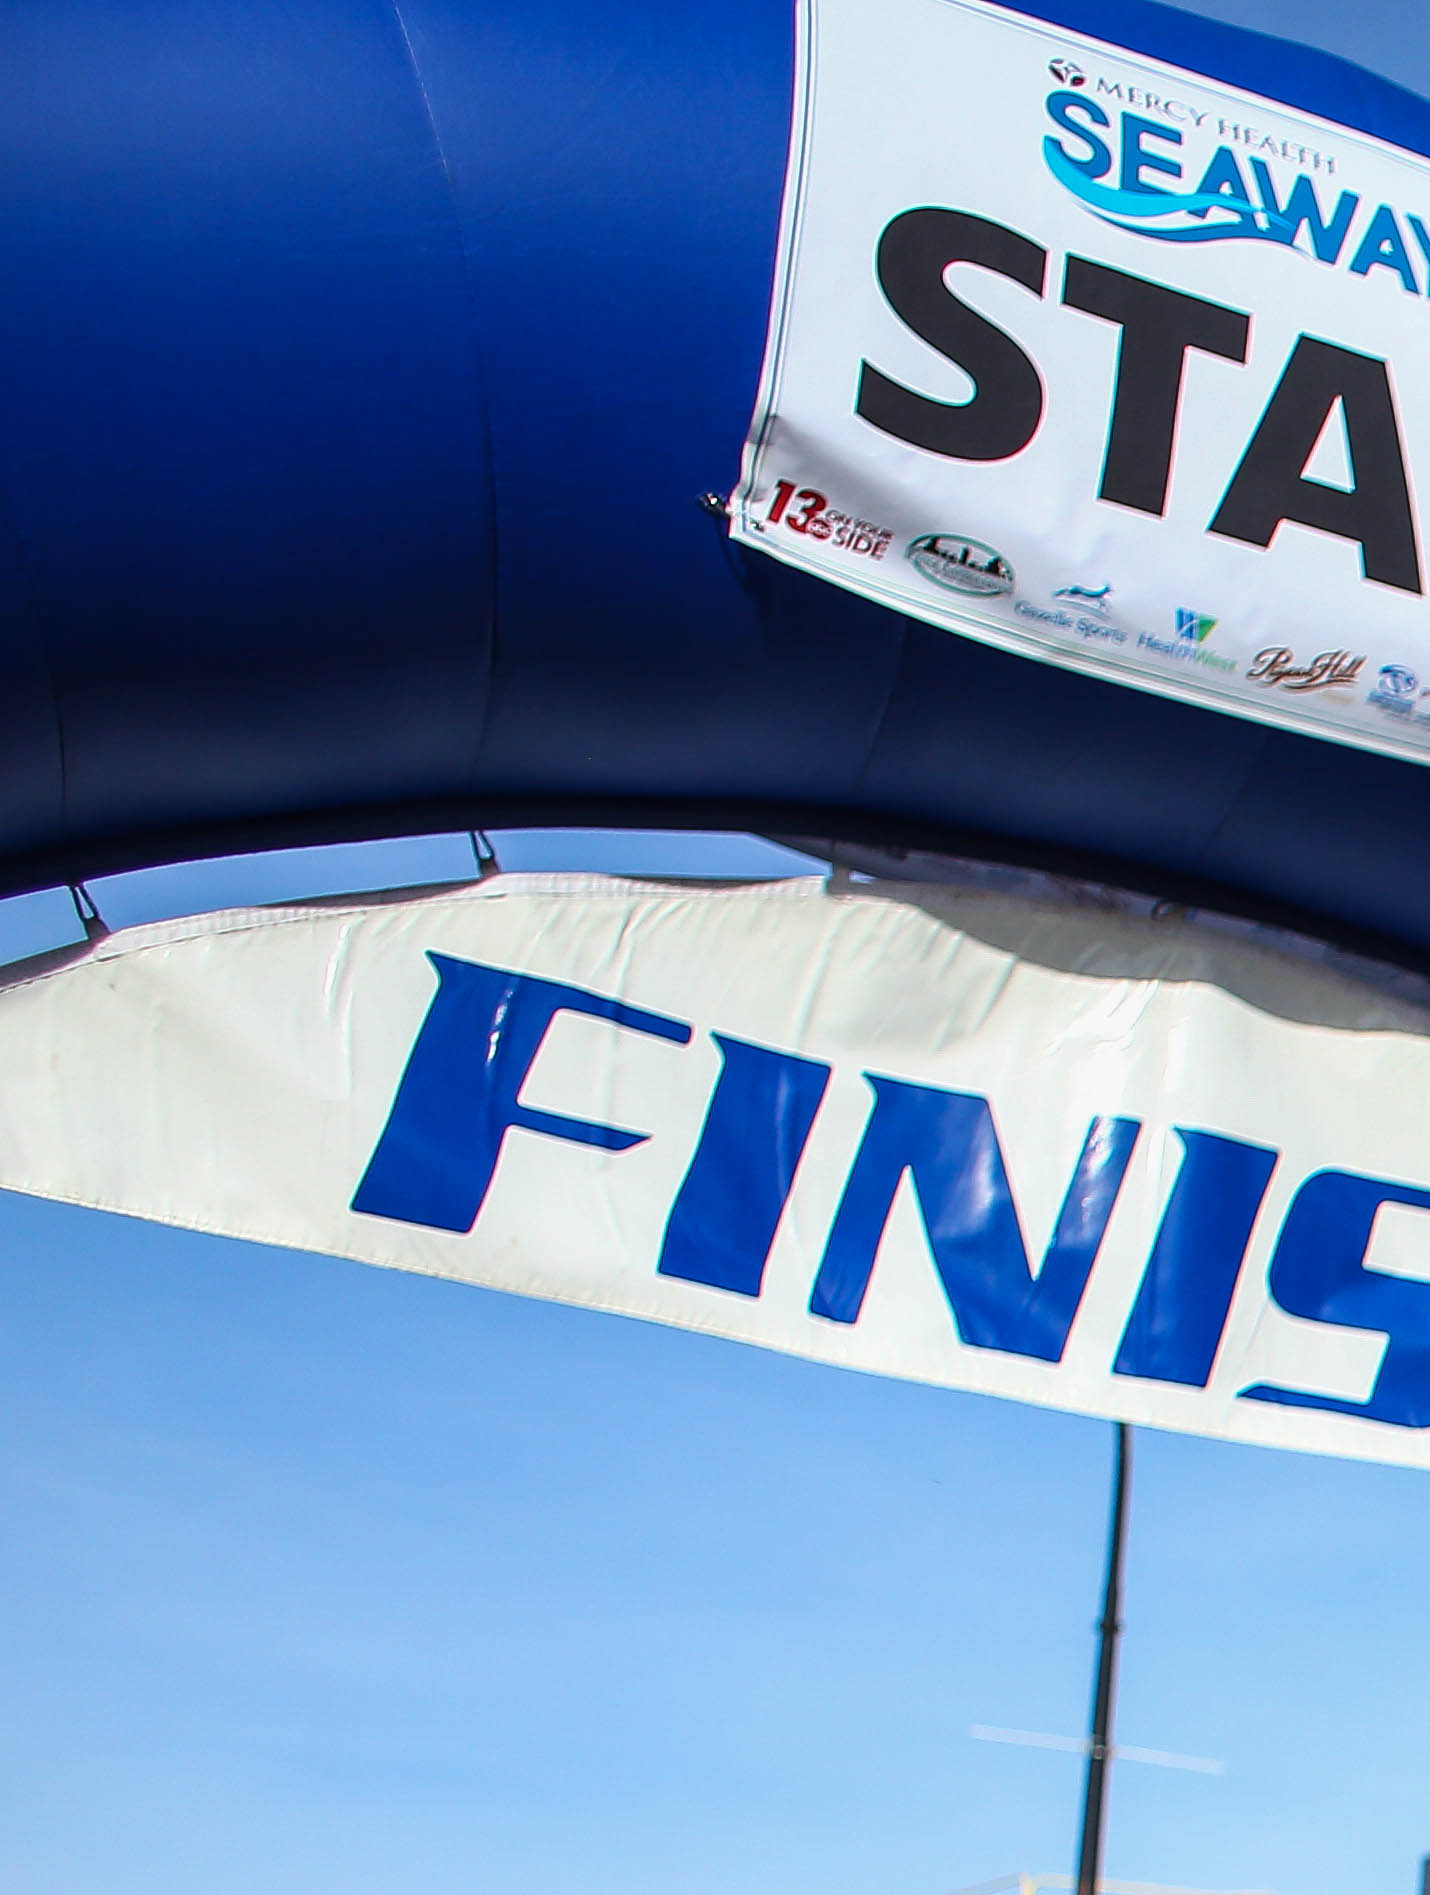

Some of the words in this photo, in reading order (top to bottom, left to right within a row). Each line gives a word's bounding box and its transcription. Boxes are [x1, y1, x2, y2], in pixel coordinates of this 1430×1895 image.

[1096, 76, 1208, 128] MERCY
[1217, 119, 1337, 177] HEALTH
[767, 478, 828, 534] 13
[831, 526, 891, 561] SIDE
